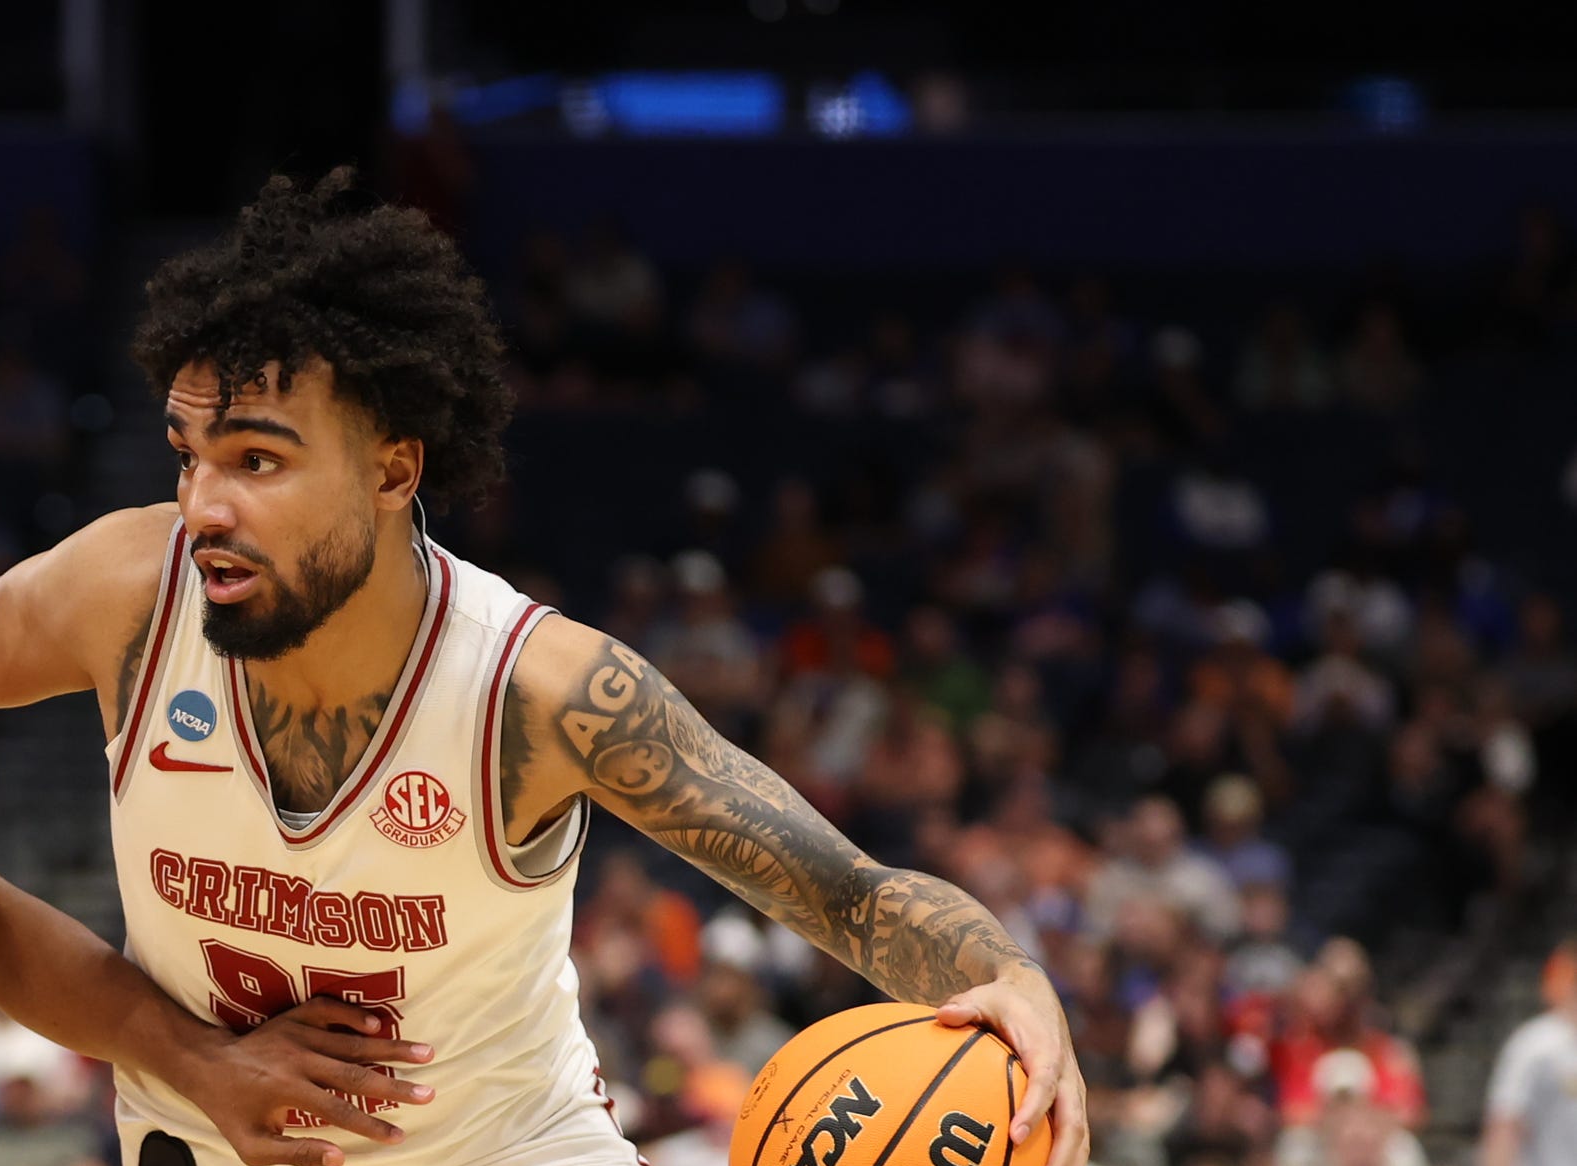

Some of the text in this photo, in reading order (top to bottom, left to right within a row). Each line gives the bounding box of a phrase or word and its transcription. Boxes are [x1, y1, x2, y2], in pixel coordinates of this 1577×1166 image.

[171, 708, 211, 736] NCAA
[388, 773, 446, 829] SEC
[382, 823, 455, 847] GRADUATE
[150, 847, 448, 953] CRIMSON
[805, 1068, 852, 1121] OFFICIAL
[780, 1124, 806, 1166] GAME
